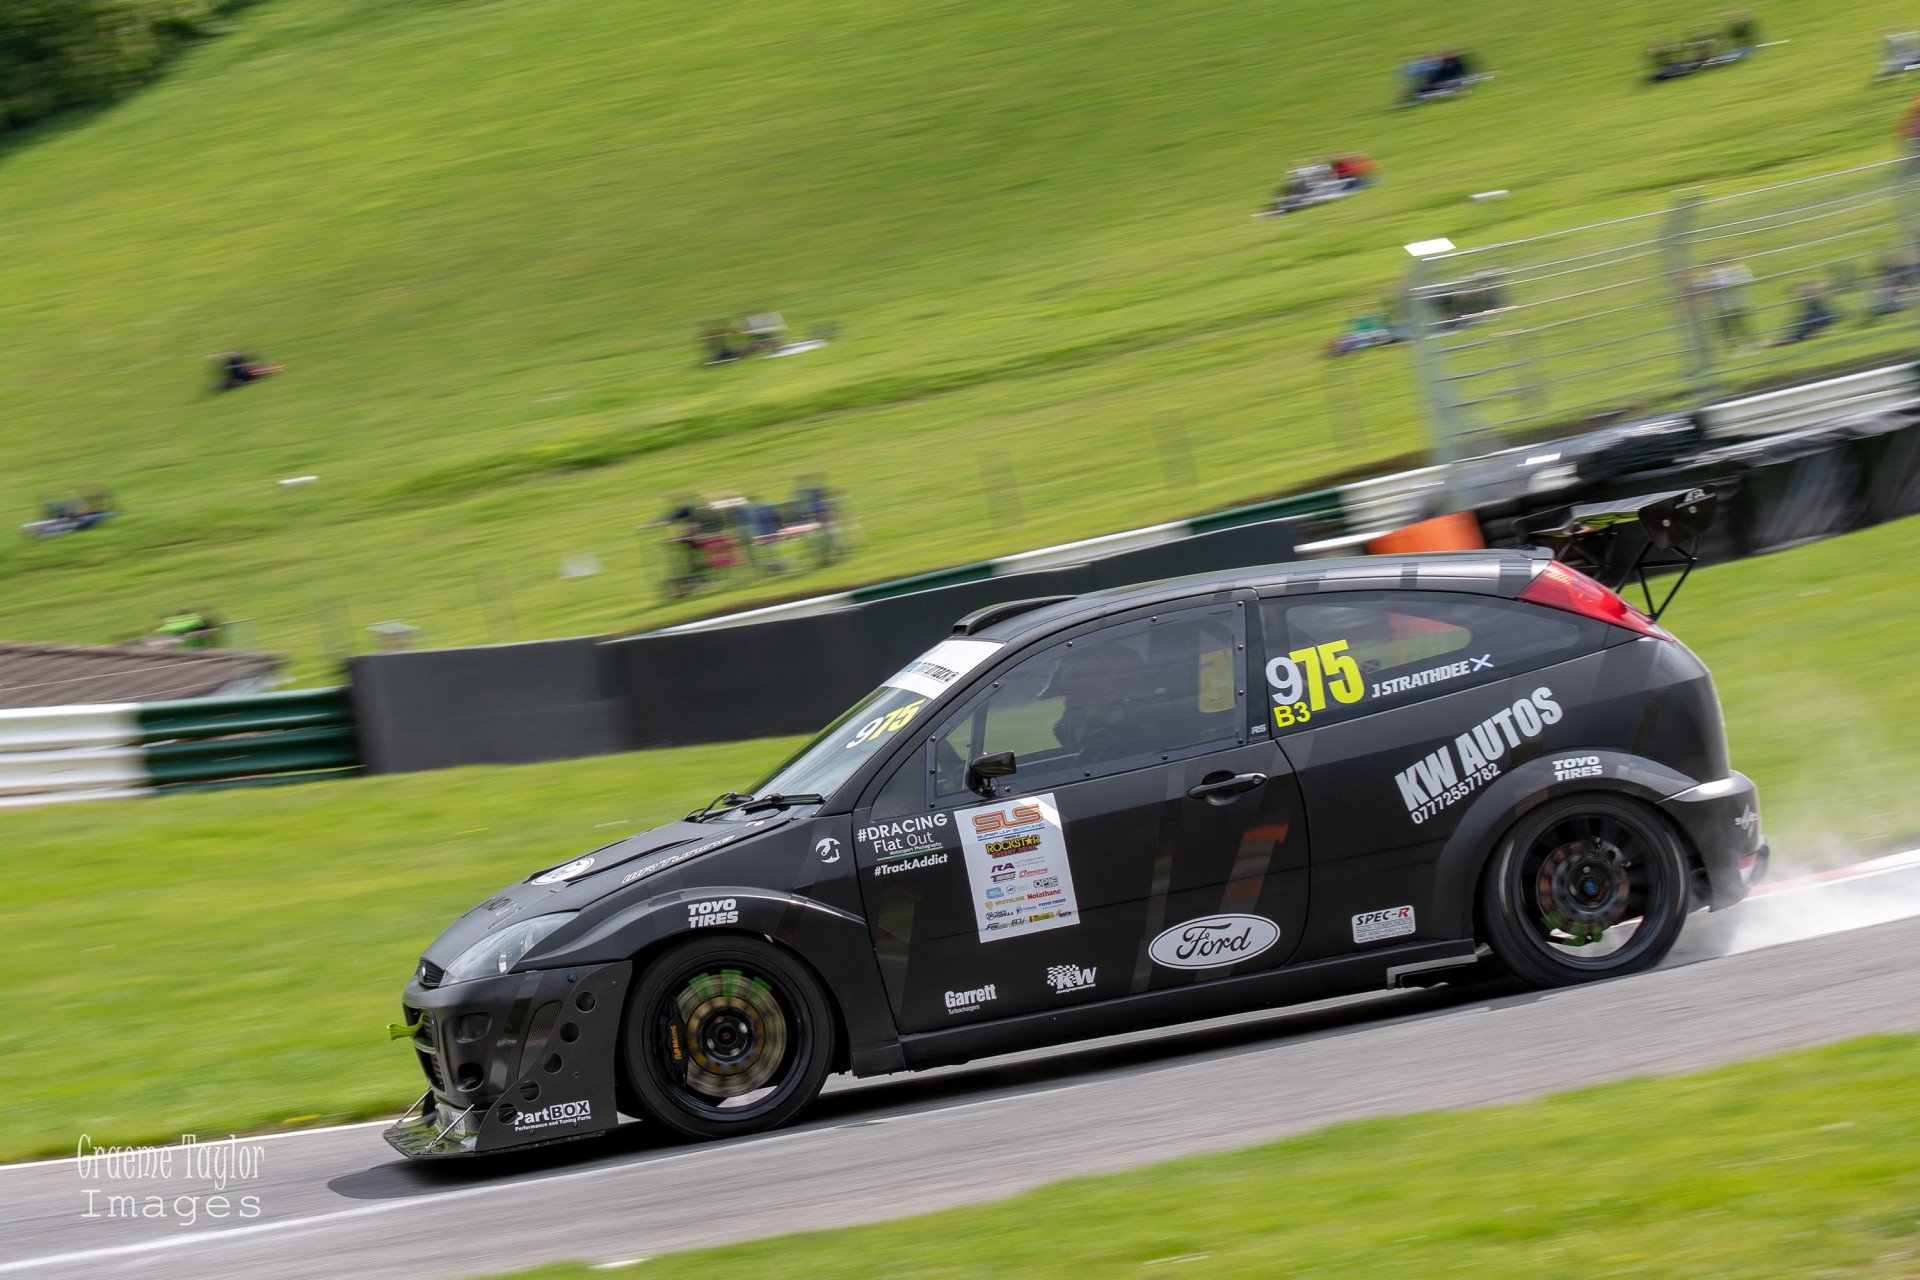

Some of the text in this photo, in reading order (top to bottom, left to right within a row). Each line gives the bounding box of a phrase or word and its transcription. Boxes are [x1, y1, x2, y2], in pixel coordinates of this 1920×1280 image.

[1266, 639, 1365, 712] 975
[1380, 660, 1471, 696] STRATHDEE
[846, 698, 926, 749] 975
[1273, 701, 1312, 728] B3
[1251, 724, 1267, 735] RS
[1395, 686, 1563, 812] KW AUTOS
[1552, 755, 1600, 770] TOYO
[1554, 765, 1603, 781] TIRES
[1411, 763, 1501, 825] 07772557782
[857, 813, 948, 843] #DRACING
[972, 804, 1043, 834] SLS
[873, 831, 935, 854] Flat Out
[874, 853, 949, 877] #TrackAddict
[991, 863, 1015, 873] RA
[1027, 889, 1063, 900] Nolathane
[688, 898, 737, 916] TOYO
[1356, 907, 1410, 926] SPEC-R
[688, 910, 739, 929] TIRES
[1175, 921, 1251, 960] Ford
[1055, 966, 1097, 990] KW
[944, 983, 997, 1008] Garrett
[515, 1122, 548, 1132] Performance
[559, 1117, 577, 1125] Tuning
